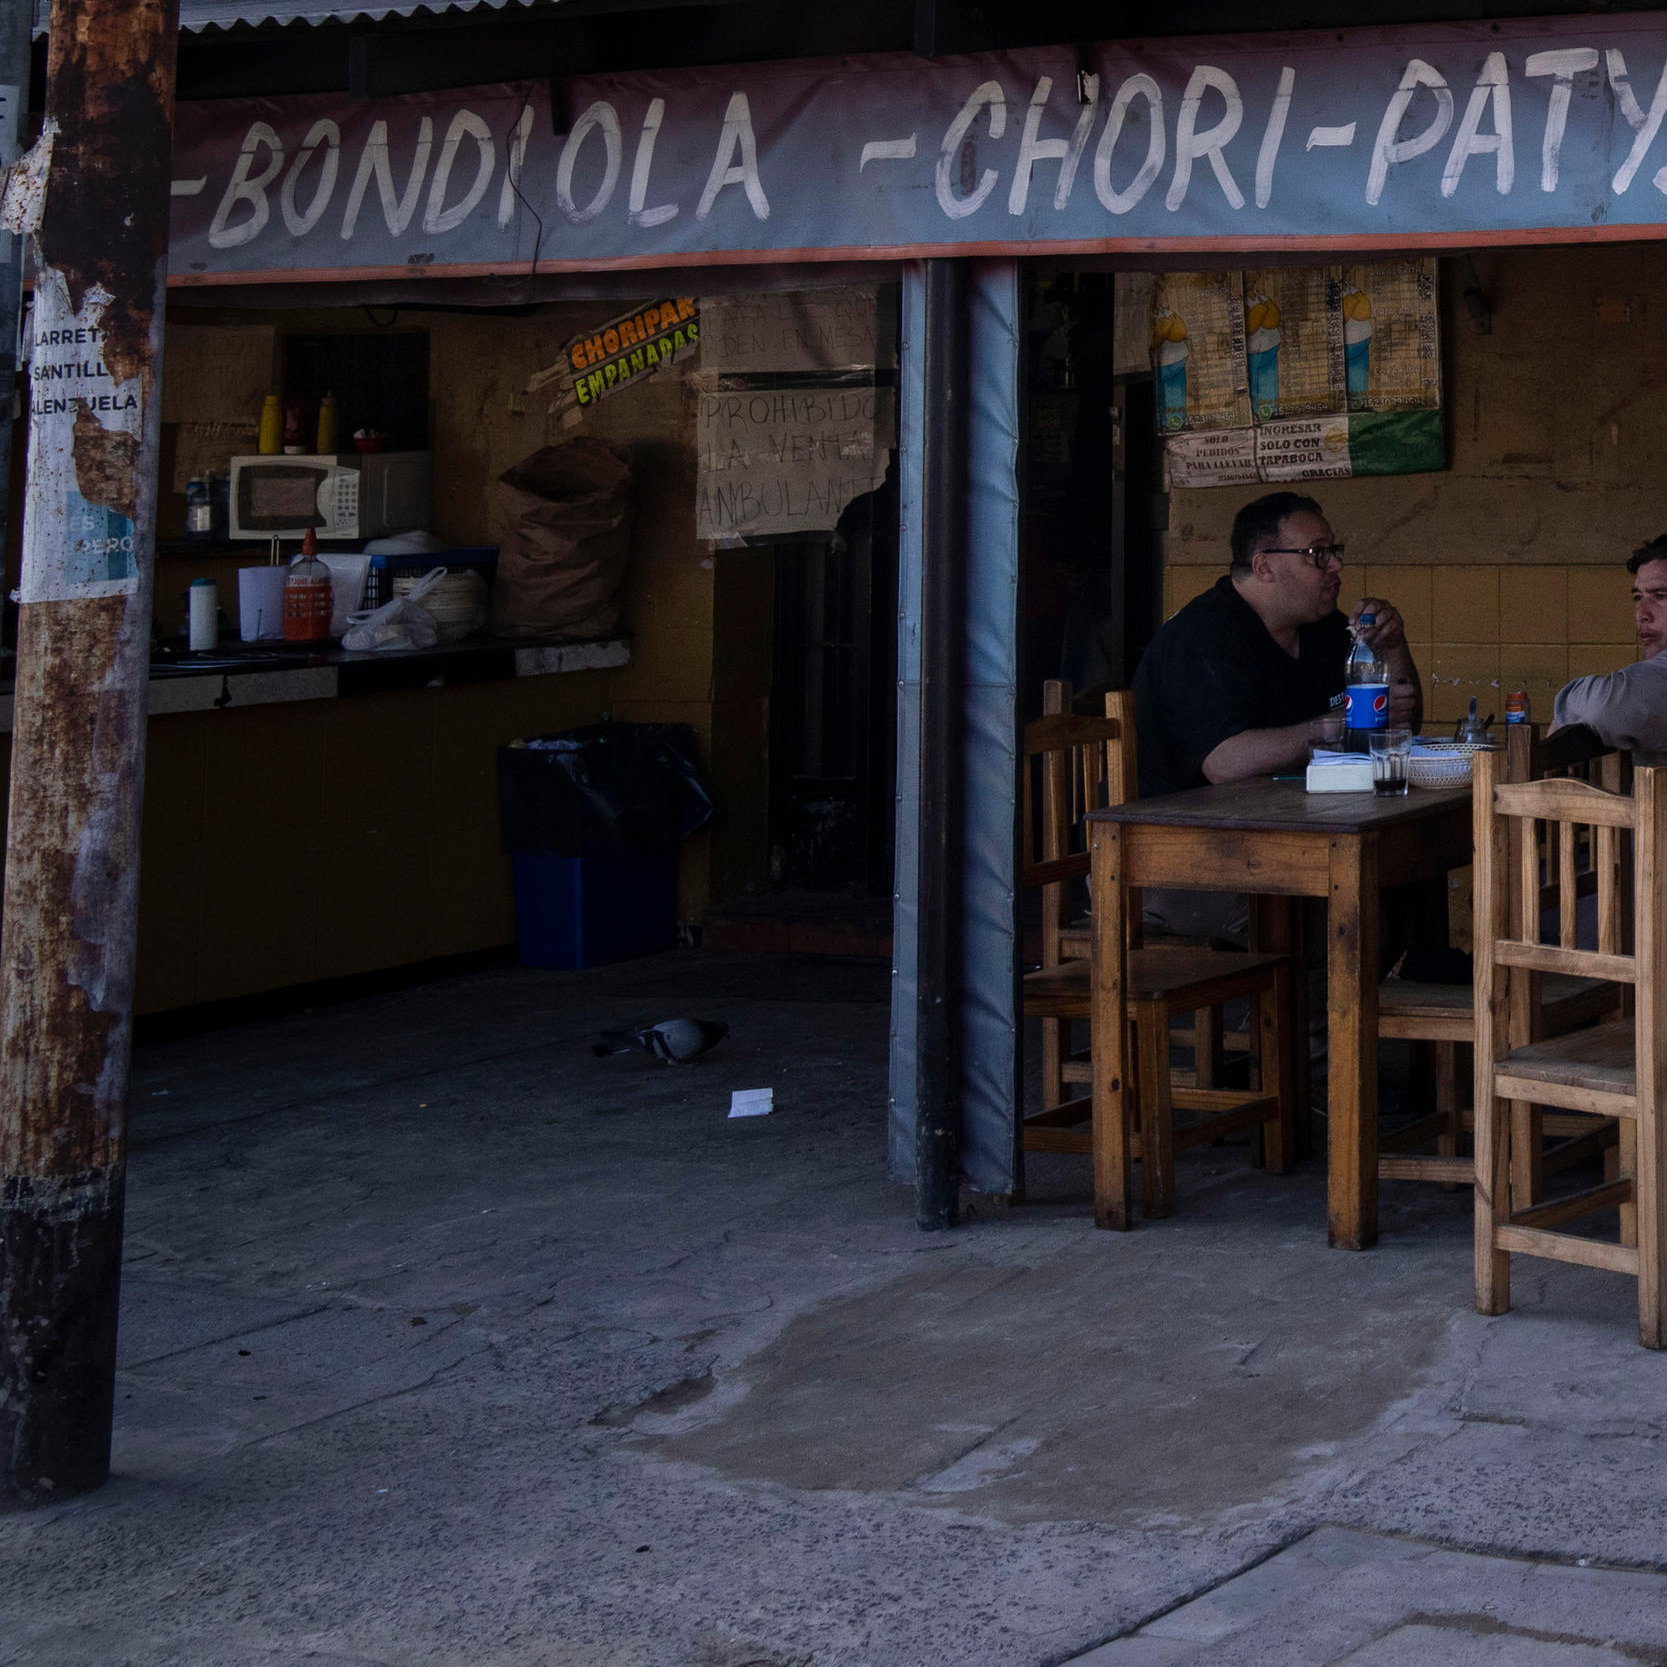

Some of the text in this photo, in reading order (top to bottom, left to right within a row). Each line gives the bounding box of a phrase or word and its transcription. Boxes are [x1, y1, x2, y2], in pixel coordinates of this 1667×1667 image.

[34, 327, 110, 348] LARRET
[574, 323, 699, 405] EMPANADAS
[1260, 423, 1321, 437] INGRESAR
[1260, 438, 1321, 451] SOLO CON
[707, 438, 749, 473] LA
[1258, 452, 1323, 465] TAPABOCA
[1302, 468, 1351, 478] GRACIAS
